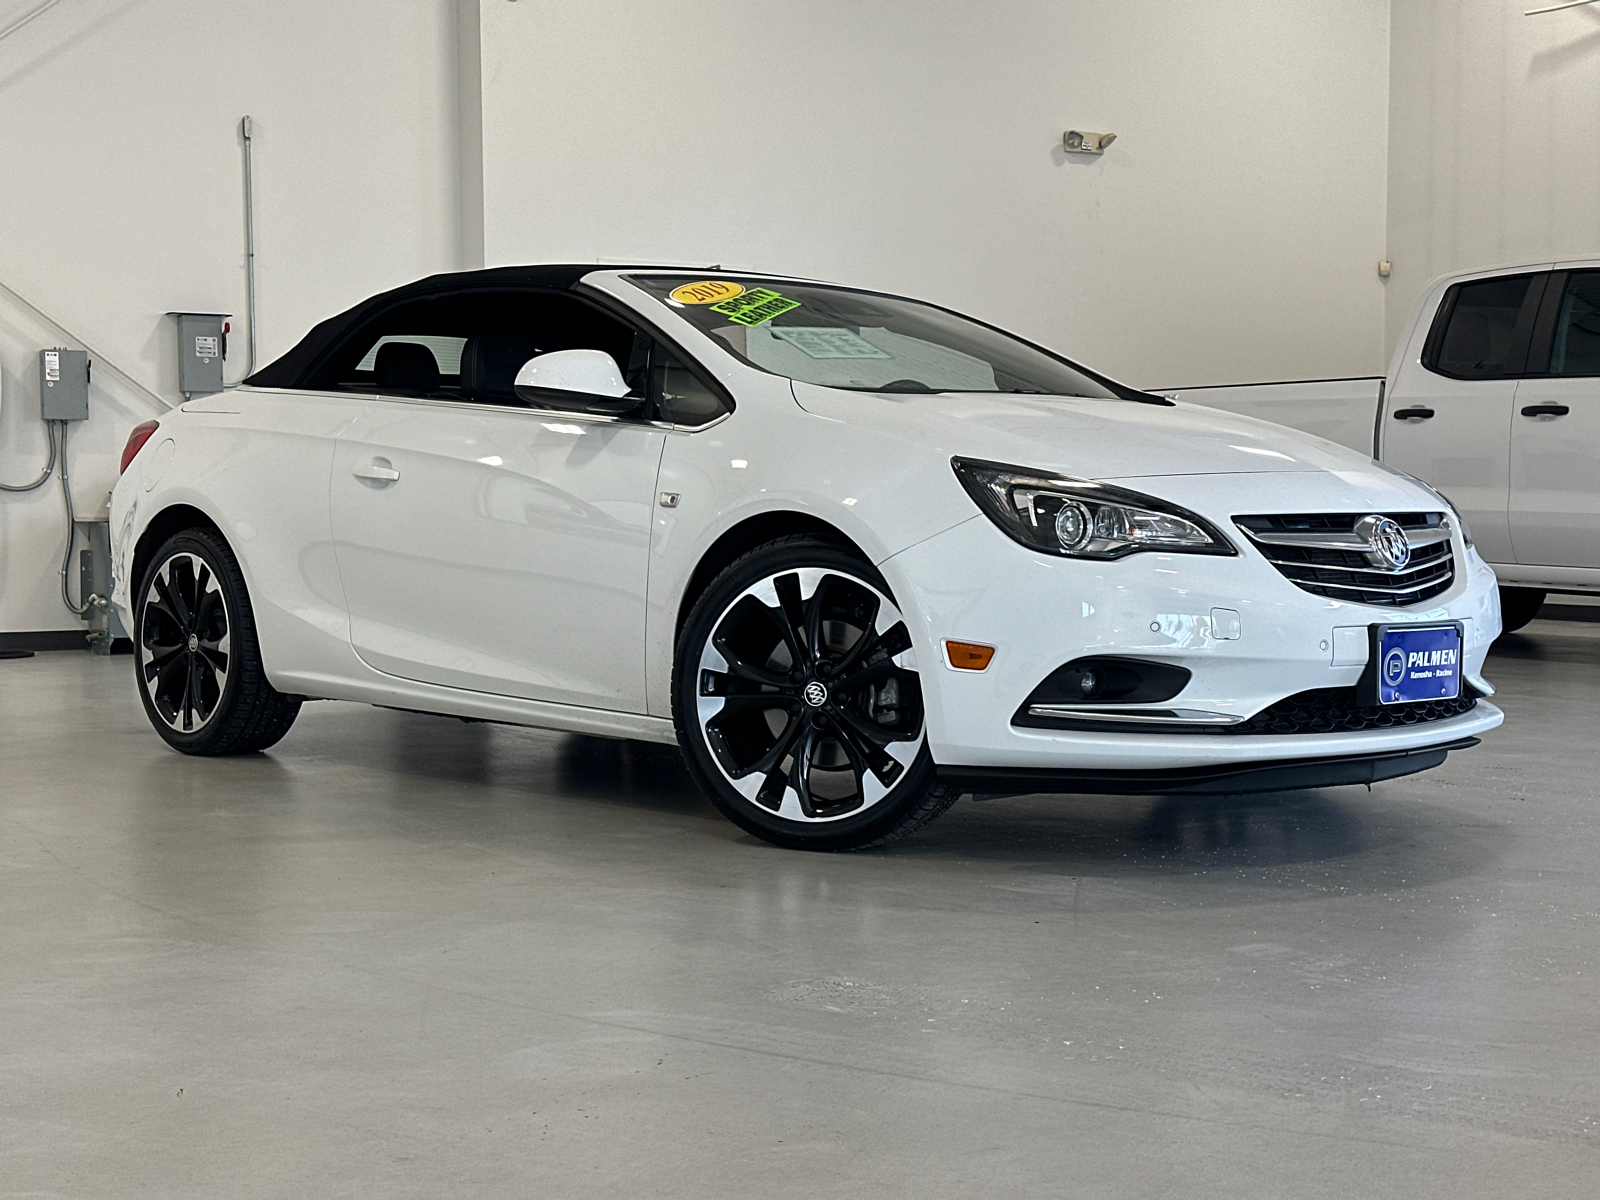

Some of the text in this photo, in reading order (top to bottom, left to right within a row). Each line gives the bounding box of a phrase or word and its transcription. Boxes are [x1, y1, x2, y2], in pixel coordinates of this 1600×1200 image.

[682, 282, 729, 302] 2019
[716, 289, 770, 313] SPORTY
[735, 297, 787, 324] LEATHER
[1407, 649, 1457, 668] PALMEN
[1410, 670, 1432, 679] Kenosha
[1436, 669, 1453, 677] Racine
